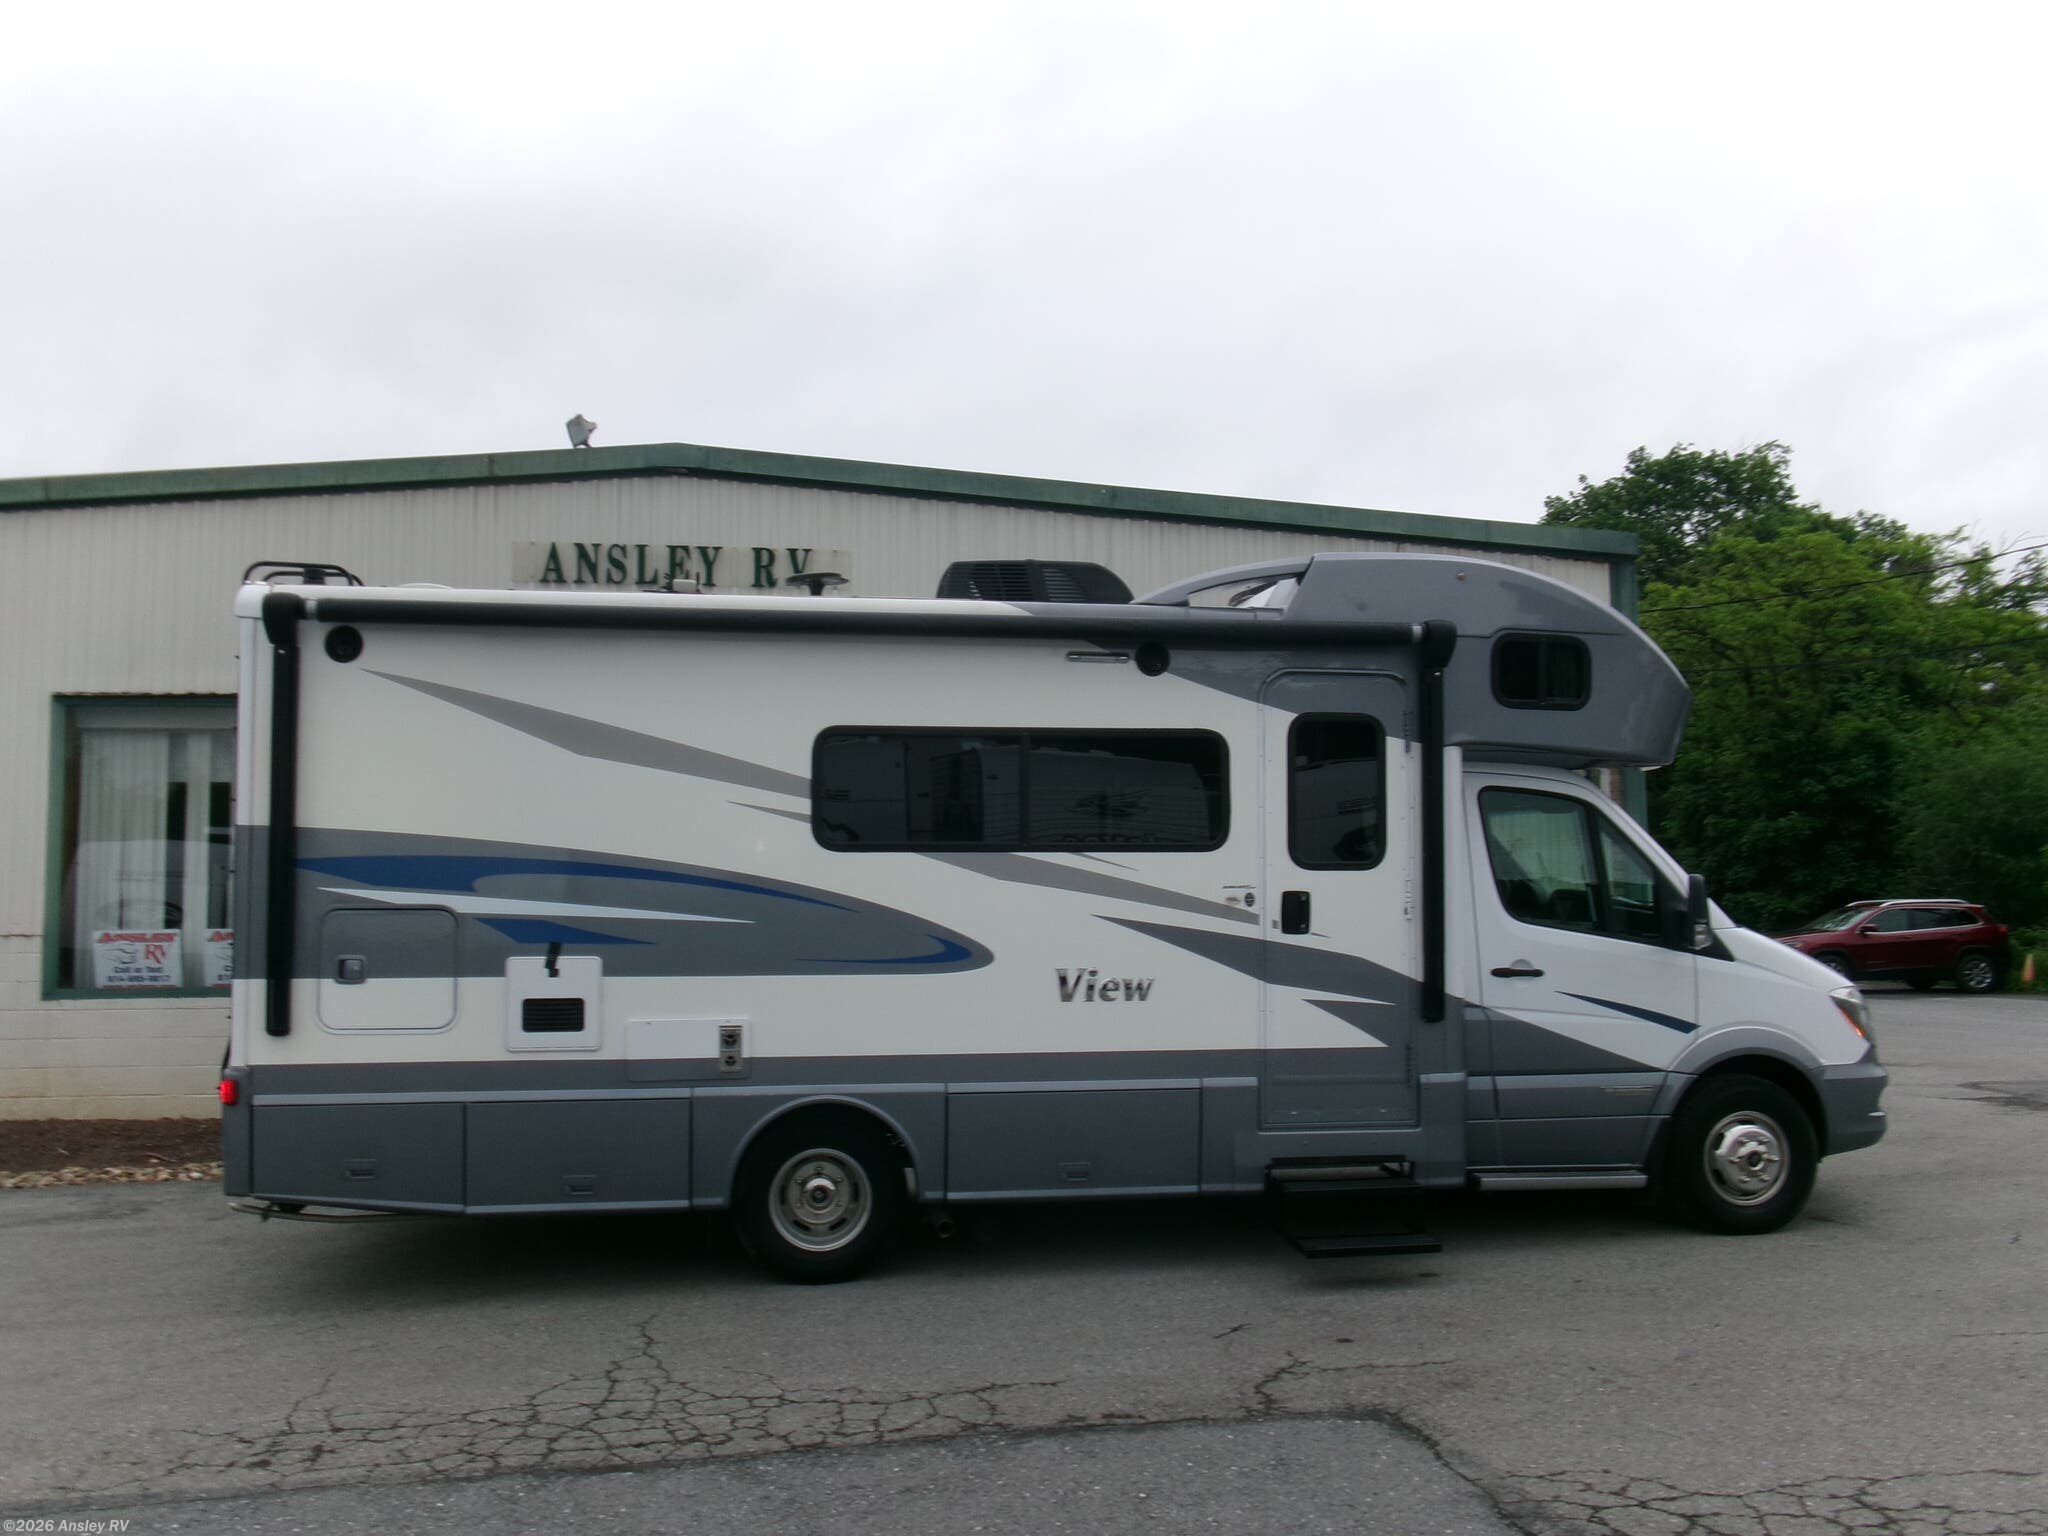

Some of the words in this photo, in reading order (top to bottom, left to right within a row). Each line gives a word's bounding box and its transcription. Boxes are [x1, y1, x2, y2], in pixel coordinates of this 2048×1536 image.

[540, 541, 723, 588] ANSLEY
[751, 546, 813, 588] RV
[1055, 967, 1155, 1002] View
